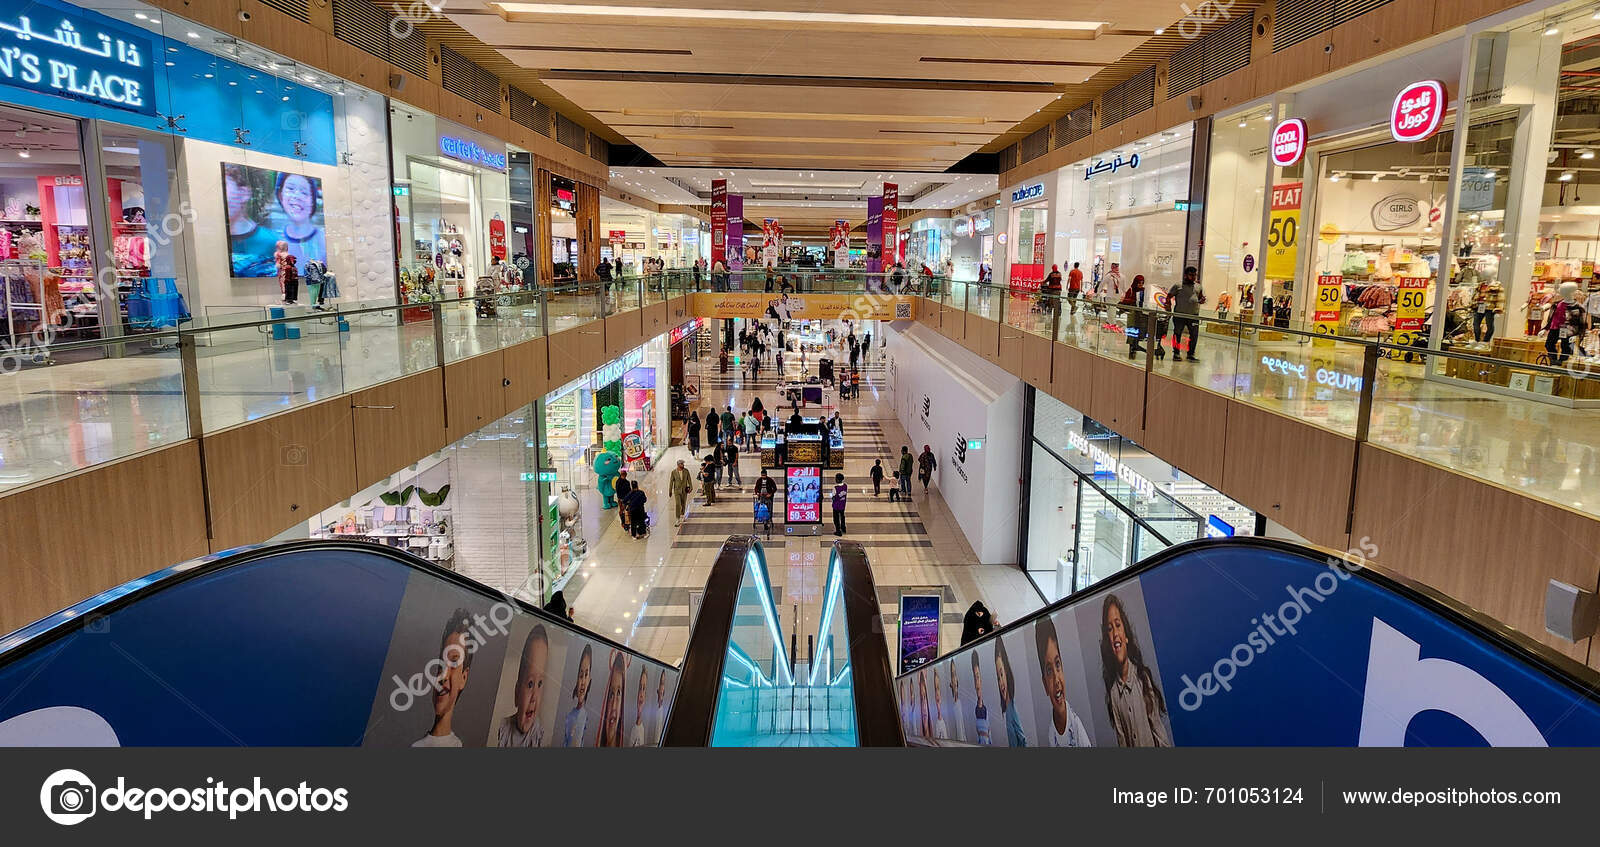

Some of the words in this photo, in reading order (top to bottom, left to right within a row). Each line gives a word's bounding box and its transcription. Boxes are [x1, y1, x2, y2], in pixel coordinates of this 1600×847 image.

[48, 59, 144, 106] PLACE
[1398, 107, 1430, 130] كوول
[1276, 130, 1297, 145] COOL
[1275, 142, 1298, 156] CLUB
[55, 176, 81, 186] girls
[1011, 181, 1044, 203] mothercare
[1272, 188, 1302, 206] FLAT
[1389, 204, 1413, 213] GIRLS
[1321, 276, 1342, 285] FLAT
[1403, 278, 1426, 288] FLAT
[1320, 288, 1340, 302] 50
[1401, 291, 1424, 308] 50
[1069, 431, 1089, 456] ZEISS
[1089, 443, 1117, 474] VISION
[1118, 463, 1155, 498] CENTER
